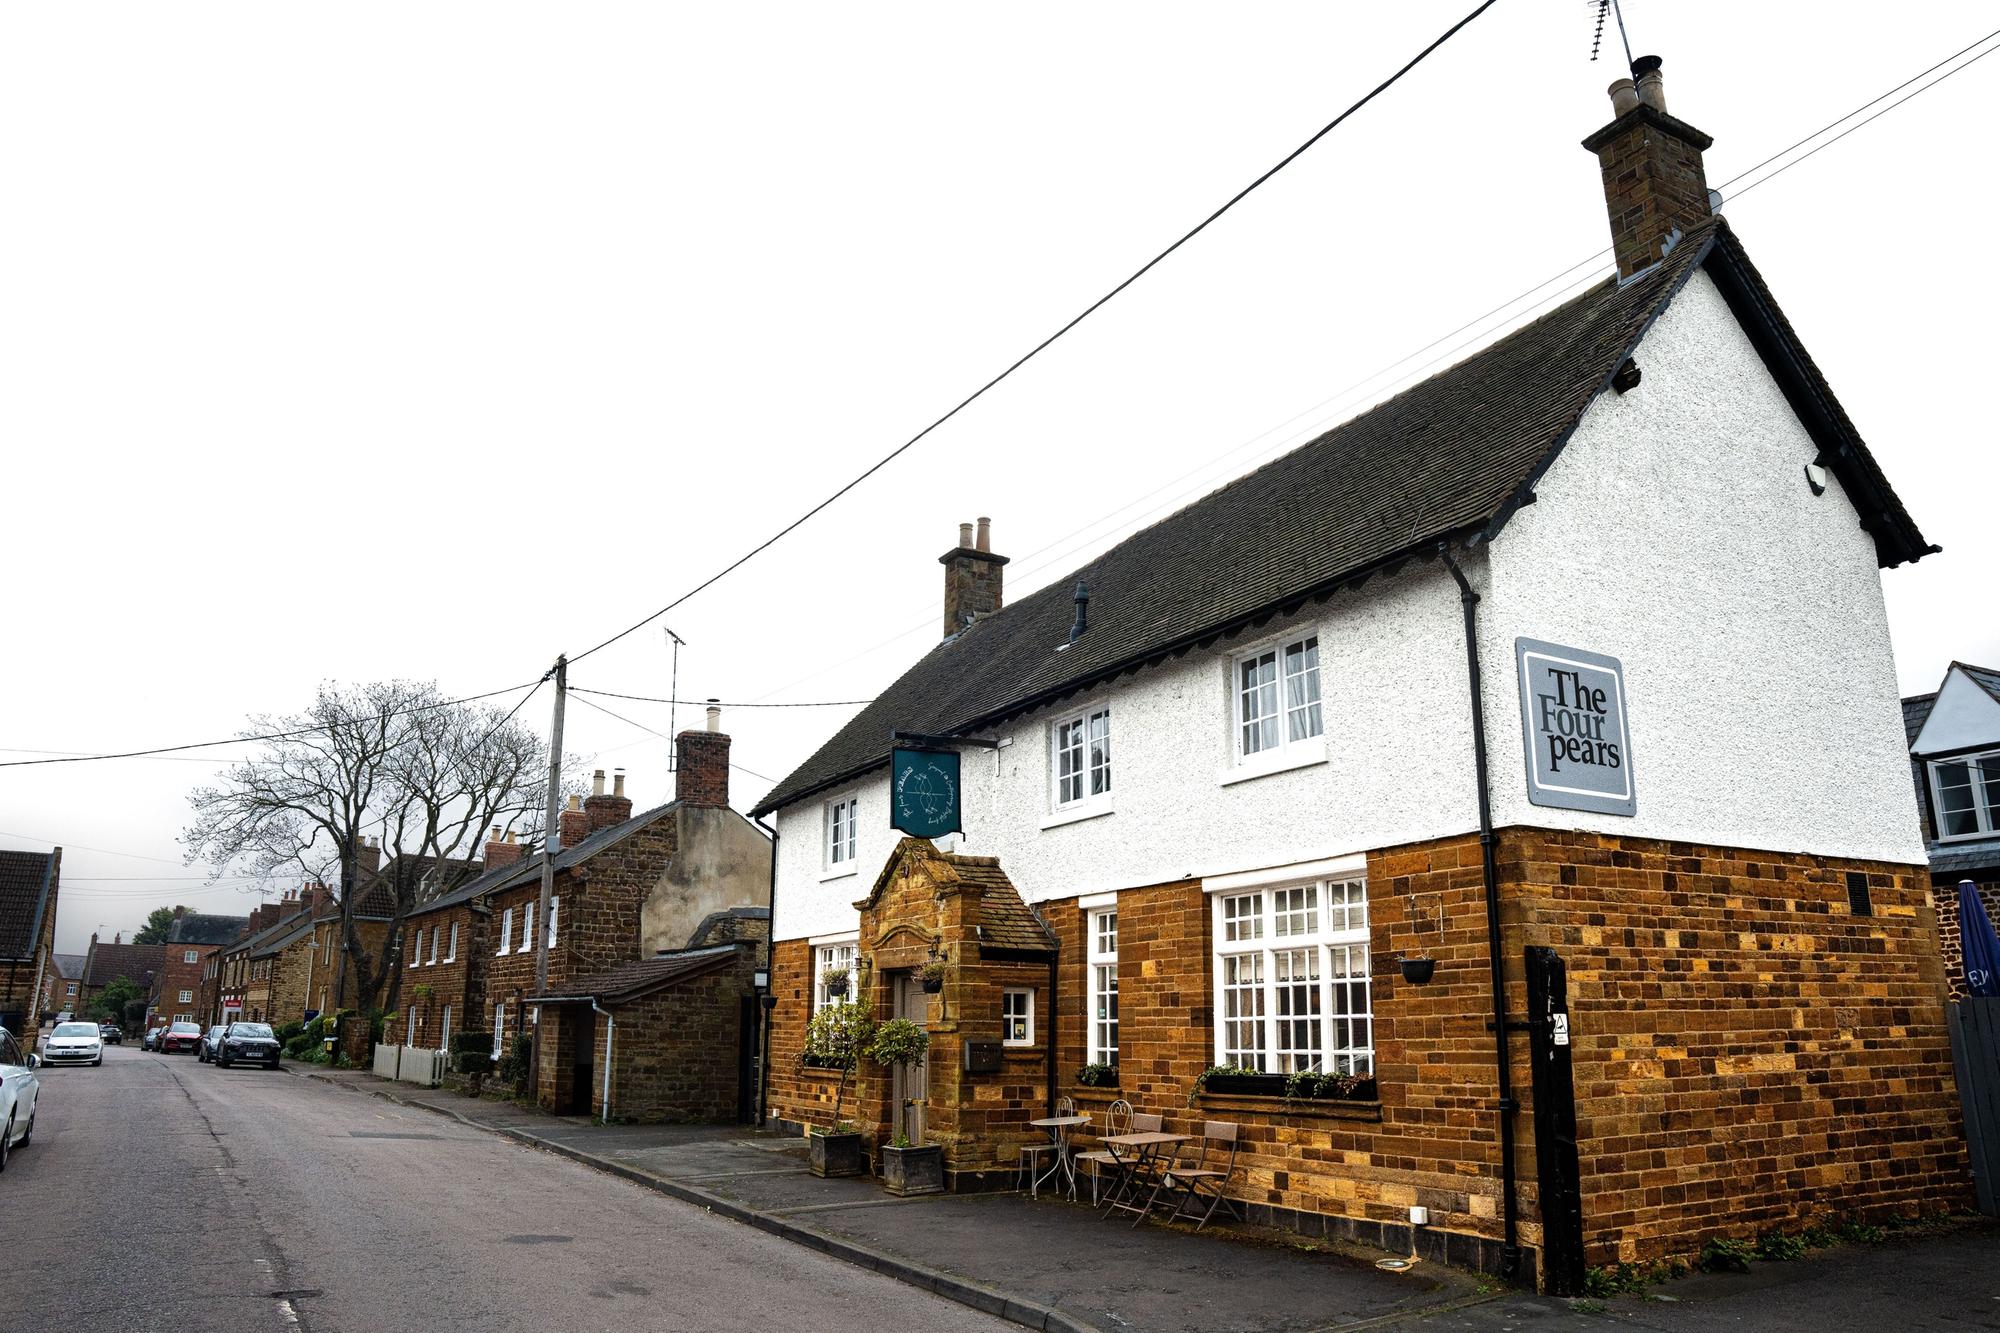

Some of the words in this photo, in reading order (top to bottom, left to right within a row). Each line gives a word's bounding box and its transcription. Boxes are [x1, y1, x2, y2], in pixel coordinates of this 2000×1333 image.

[1548, 668, 1607, 715] The
[1537, 693, 1605, 741] Four
[1547, 735, 1620, 772] pears
